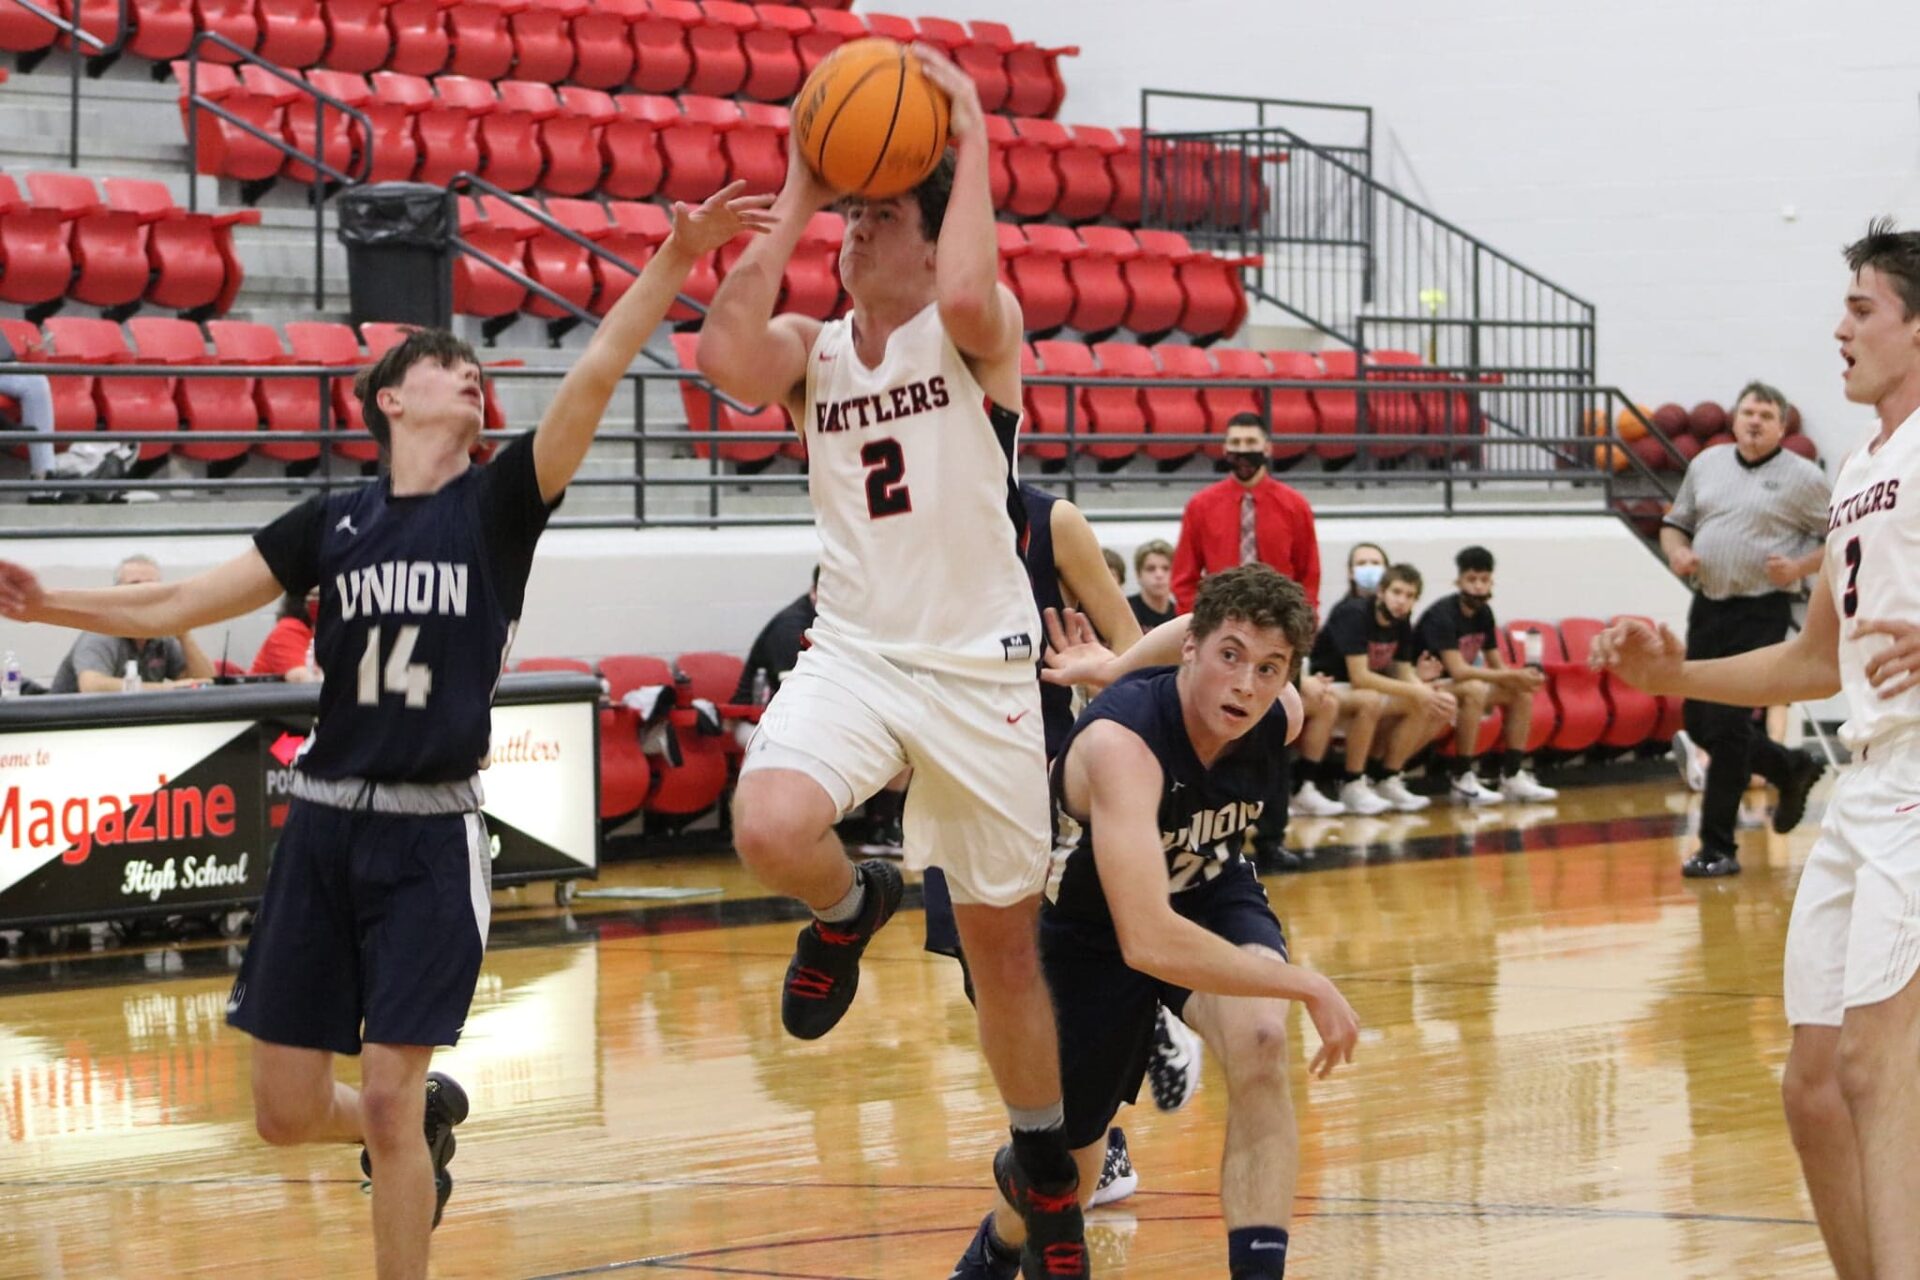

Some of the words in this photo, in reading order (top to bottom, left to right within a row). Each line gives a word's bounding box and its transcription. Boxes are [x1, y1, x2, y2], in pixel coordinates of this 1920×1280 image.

[860, 437, 912, 520] 2
[336, 560, 468, 622] UNION
[357, 624, 432, 709] 14
[121, 857, 177, 901] High
[180, 852, 249, 889] School
